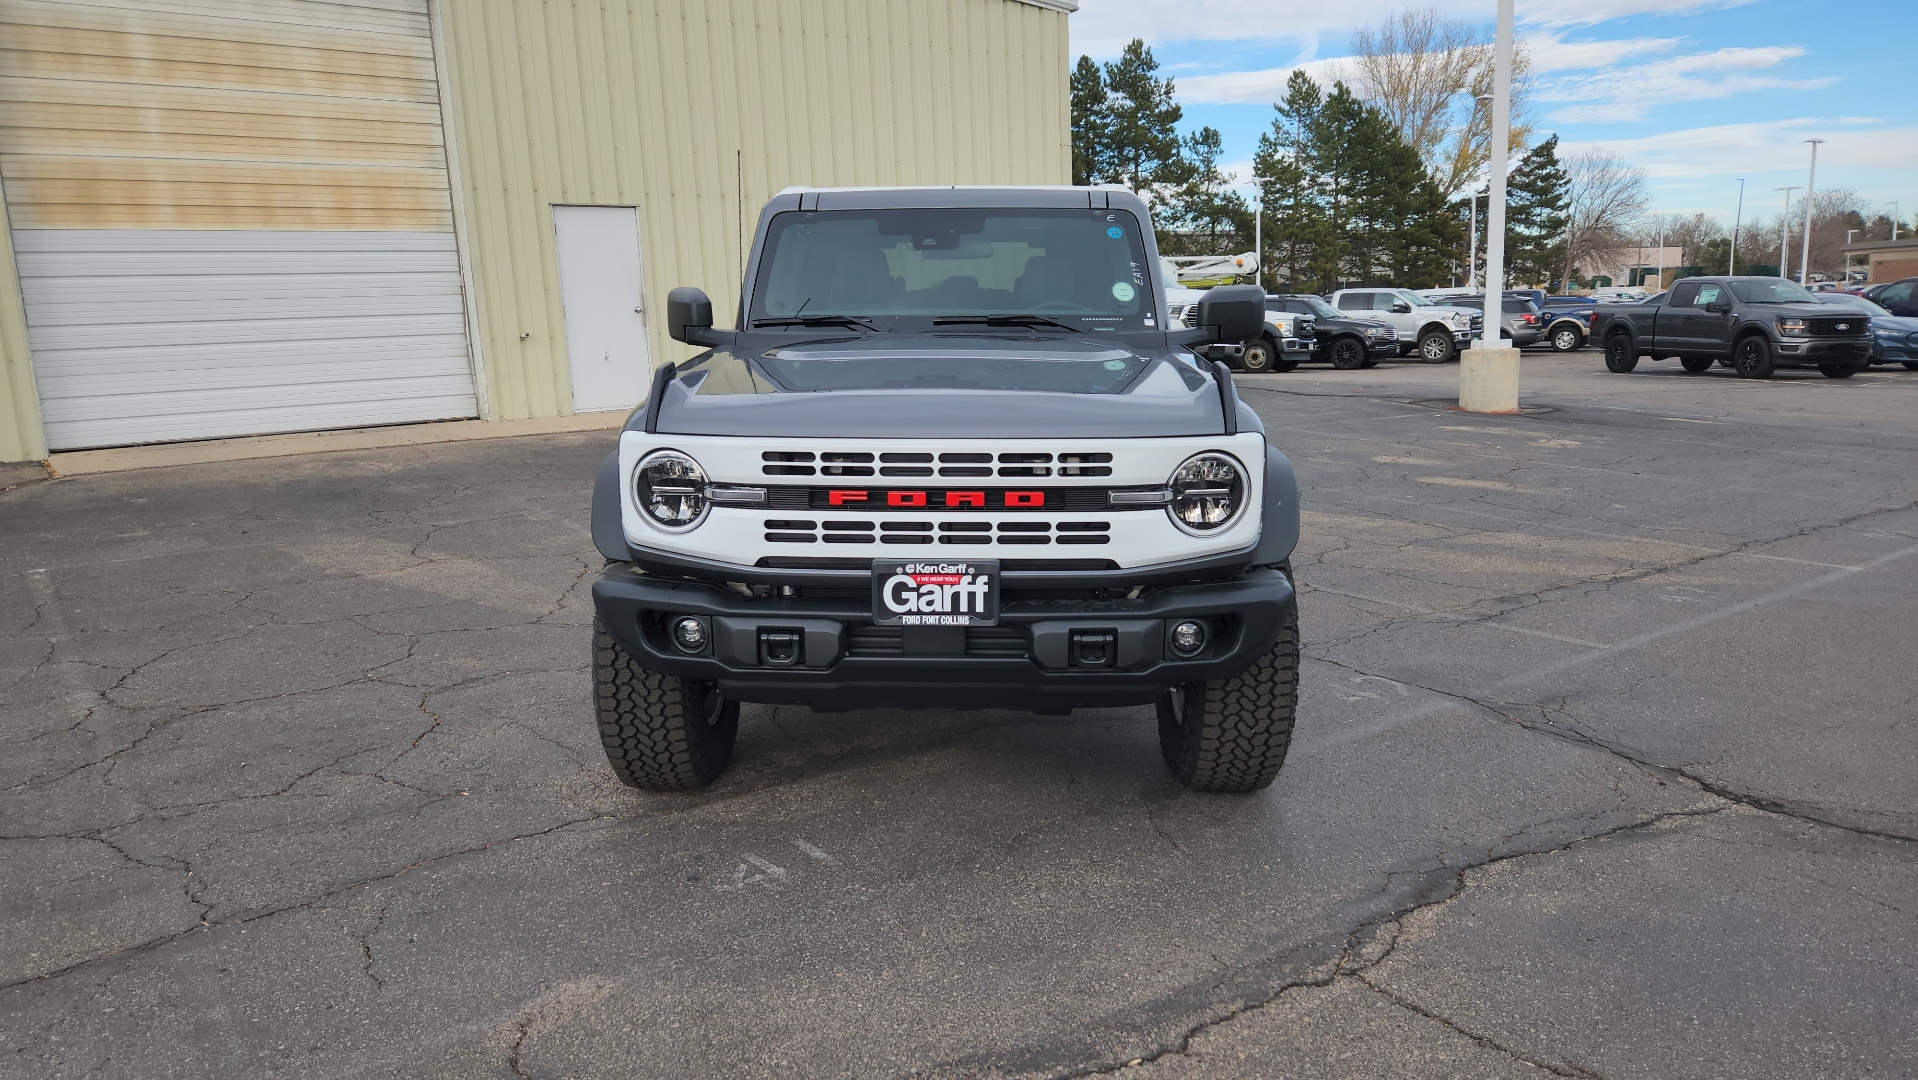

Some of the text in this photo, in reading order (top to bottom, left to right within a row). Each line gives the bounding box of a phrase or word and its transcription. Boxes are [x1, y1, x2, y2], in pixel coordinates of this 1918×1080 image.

[828, 490, 1045, 507] FORD
[915, 563, 938, 574] Ken
[938, 563, 967, 574] Garff
[883, 574, 989, 614] Garff
[902, 615, 970, 625] FORD FORT COLLINS
